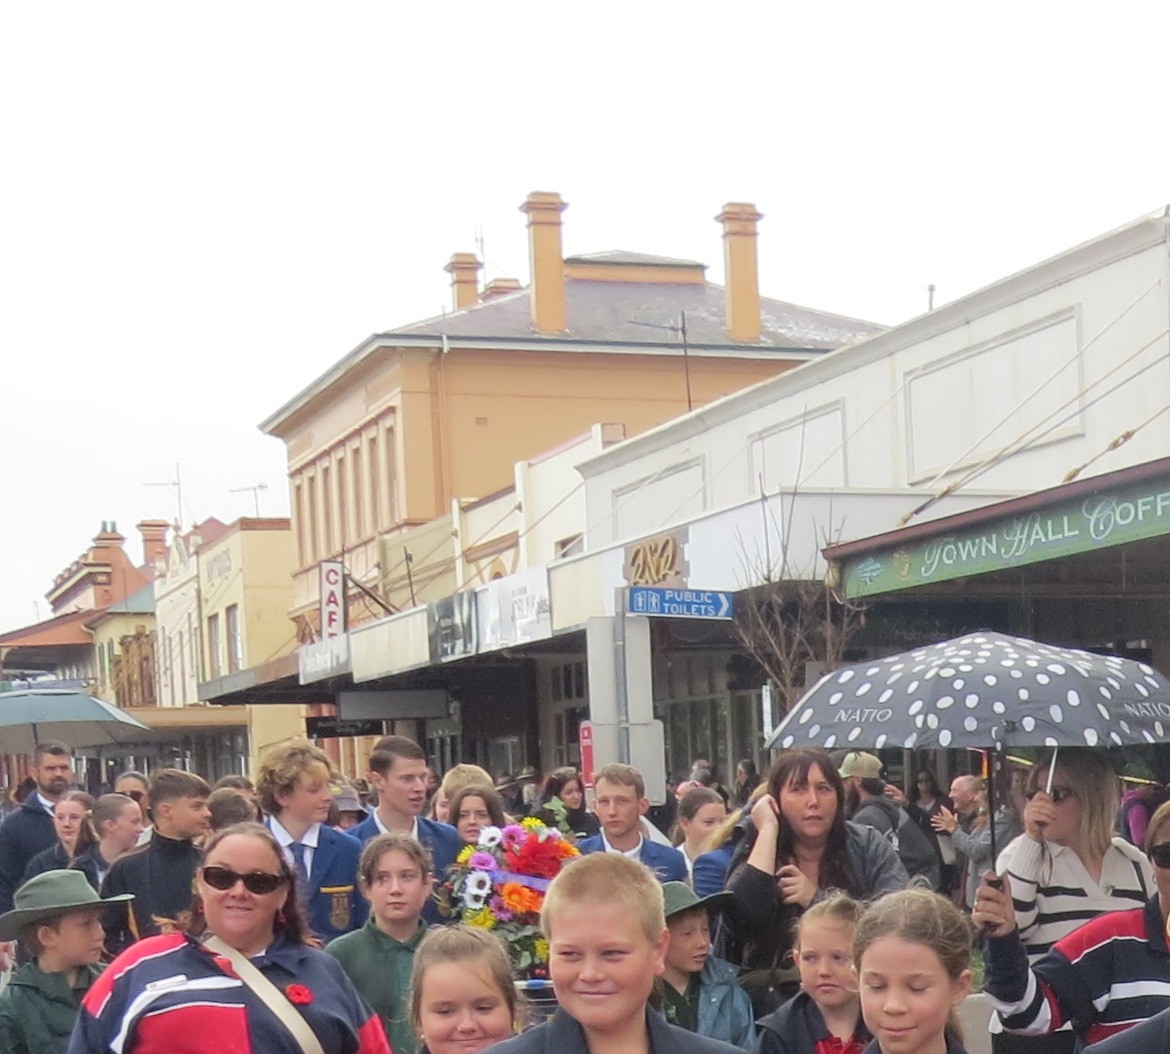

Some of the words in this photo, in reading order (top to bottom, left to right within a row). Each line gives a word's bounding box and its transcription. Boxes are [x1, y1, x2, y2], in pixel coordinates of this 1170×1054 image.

[665, 590, 713, 603] PUBLIC
[324, 568, 340, 640] CAF
[663, 603, 716, 615] TOILETS
[834, 708, 892, 722] NATIO
